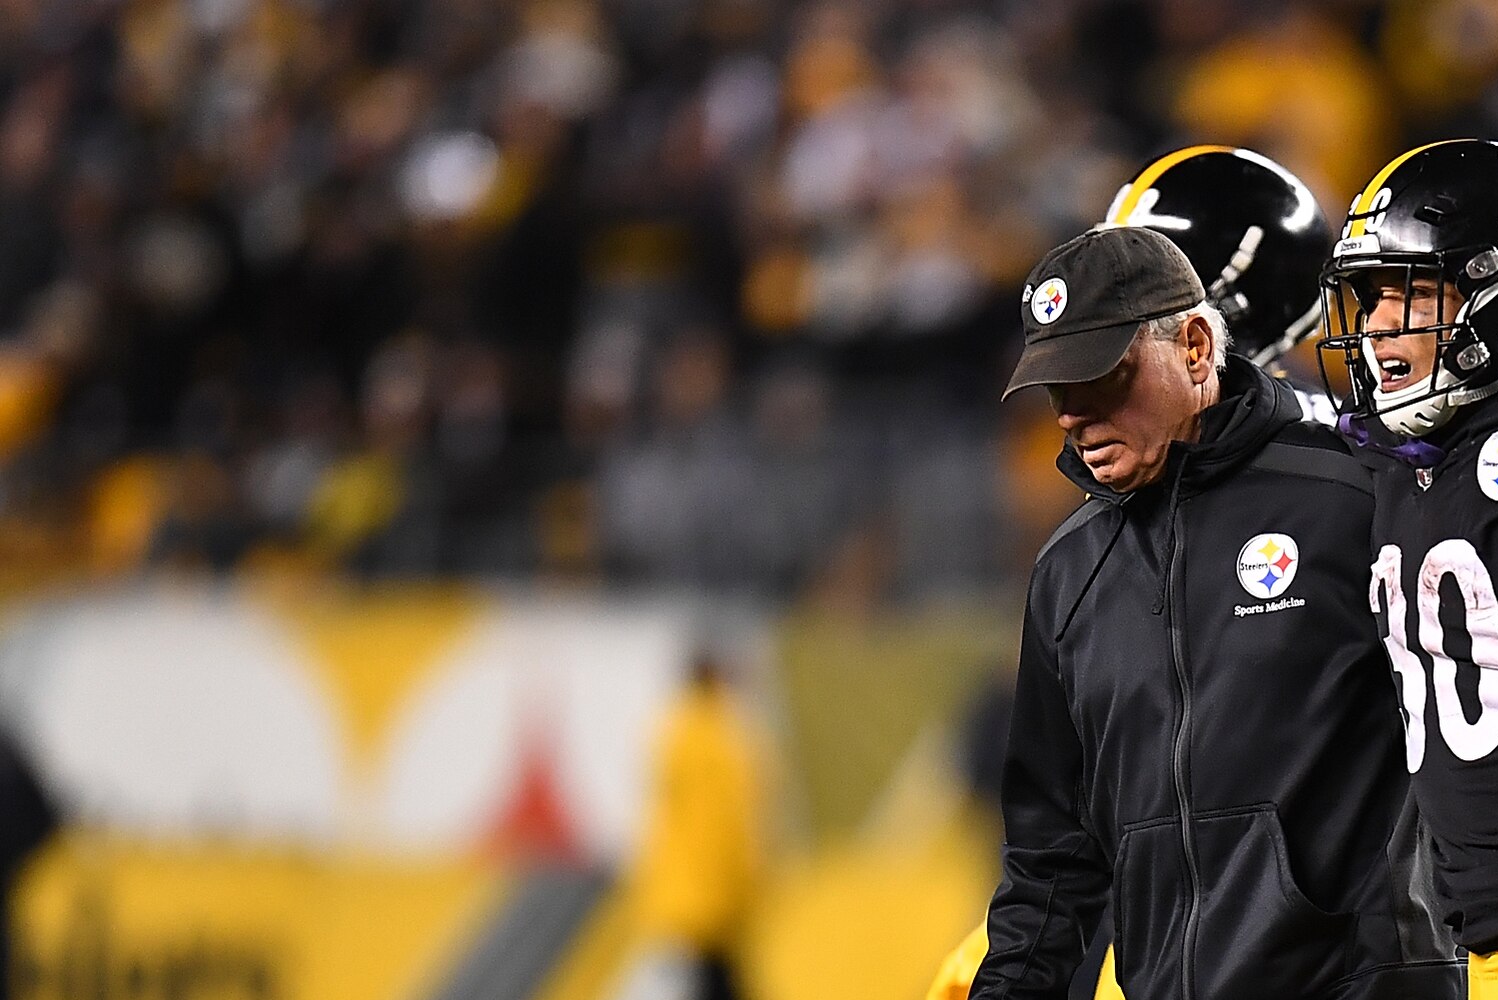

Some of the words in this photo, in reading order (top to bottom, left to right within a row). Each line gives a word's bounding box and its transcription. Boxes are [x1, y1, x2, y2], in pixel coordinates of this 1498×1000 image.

[1240, 562, 1268, 571] Steelers
[1234, 605, 1264, 617] Sports
[1265, 597, 1305, 612] Medicine
